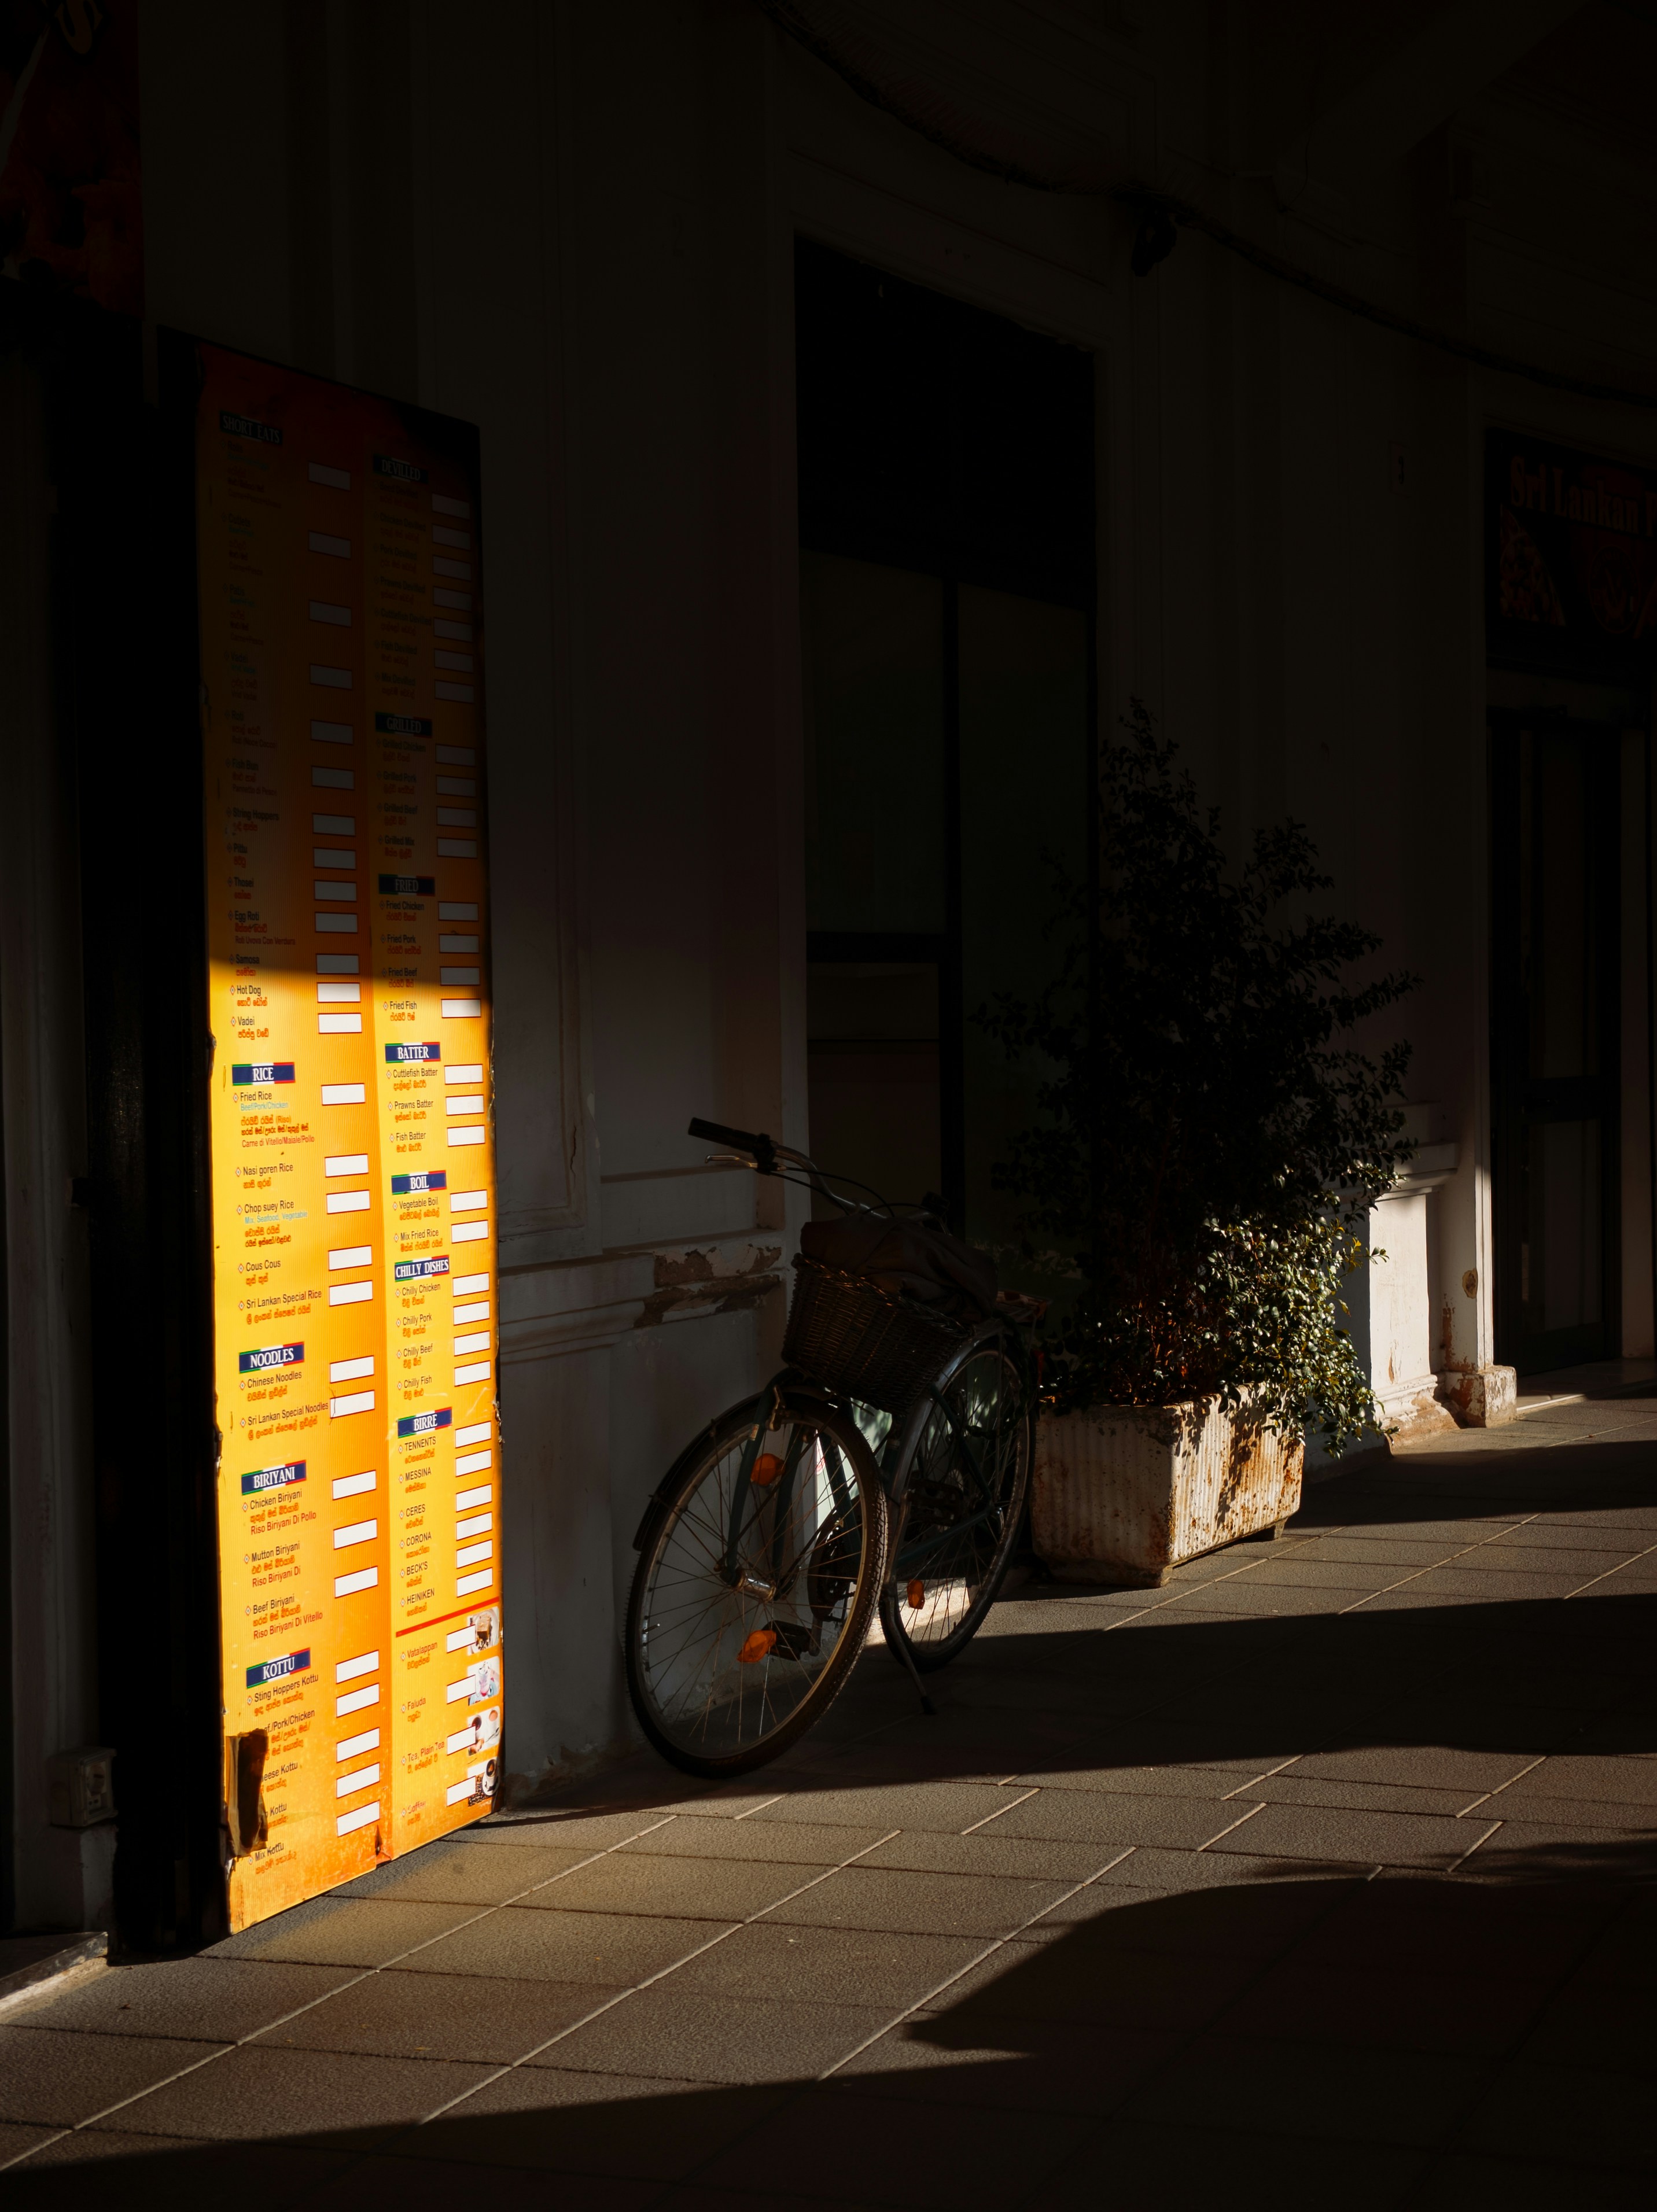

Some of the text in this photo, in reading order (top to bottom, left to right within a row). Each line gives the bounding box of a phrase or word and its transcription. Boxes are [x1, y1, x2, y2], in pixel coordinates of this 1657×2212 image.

[223, 415, 279, 444] SHORT EATS
[382, 459, 421, 481] DEVILLED
[1510, 455, 1546, 513] Sri
[1552, 466, 1639, 534] Lankan
[381, 640, 393, 650] Fish
[232, 711, 243, 721] Roti
[387, 717, 421, 733] GRILLED
[383, 739, 426, 752] Grilled Chicken
[233, 758, 258, 770] Fish Bun
[384, 770, 417, 783] Grilled Pork
[233, 808, 279, 820] String Hoppers
[384, 803, 417, 814] Grilled Beef
[385, 835, 415, 846] Grilled Mix
[234, 843, 247, 853] Pittu
[234, 877, 253, 887] Thosei
[395, 879, 418, 891] FRIED
[386, 901, 424, 911] Fried Chicken
[235, 912, 259, 922] Egg Roti
[388, 934, 416, 943] Fried Pork
[236, 954, 259, 964] Samosa
[389, 968, 417, 976] Fried Beef
[237, 985, 261, 997] Hot Dog
[390, 1001, 417, 1009] Fried Fish
[238, 1016, 255, 1026] Vadei
[397, 1046, 429, 1059] BATTER
[253, 1067, 274, 1081] RICE
[393, 1069, 419, 1078] Cuttlefish
[241, 1091, 271, 1101] Fried Rice
[395, 1100, 433, 1109] Prawns Batter
[276, 1116, 291, 1124] (Riso)
[242, 1136, 315, 1148] Carne di Vitello/Maiale/Pollo
[396, 1131, 426, 1141] Fish Batter
[244, 1163, 293, 1176] Nasi goren Rice
[410, 1176, 429, 1190] BOIL
[245, 1200, 294, 1214] Chop suey Rice
[399, 1197, 439, 1210] Vegetable Boil
[401, 1229, 439, 1241] Mix Fried Rice
[246, 1259, 281, 1271] Cous Cous
[396, 1259, 448, 1277] CHILLY DISHES
[403, 1283, 440, 1296] Chilly Chicken
[246, 1290, 322, 1308] Sri Lankan Special Rice
[403, 1314, 432, 1326] Chilly Pork
[404, 1343, 433, 1357] Chilly Beef
[251, 1348, 294, 1368] NOODLES
[248, 1371, 301, 1388] Chinese Noodles
[404, 1376, 432, 1388] Chilly Fish
[248, 1402, 328, 1425] Sri Lankan Special Noodles
[414, 1414, 437, 1431] BIRRE
[405, 1437, 436, 1451] TENNENTS
[253, 1466, 295, 1489] BIRIYANI
[406, 1467, 431, 1481] MESSINA
[250, 1489, 302, 1510] Chicken Biriyani
[406, 1504, 425, 1517] CERES
[251, 1511, 316, 1535] Riso Biriyani Di Pollo
[407, 1532, 432, 1546] CORONA
[252, 1541, 300, 1562] Mutton Biriyani
[407, 1561, 428, 1575] BECK'S
[252, 1566, 300, 1587] Riso Biriyani Di
[407, 1588, 434, 1604] HEINIKEN
[253, 1594, 294, 1614] Beef Biriyani
[254, 1611, 322, 1639] Riso Biriyani Di Vitello
[407, 1642, 437, 1658] Vatalappan
[263, 1657, 295, 1679] KOTTU
[255, 1673, 318, 1702] Sting Hoppers Kottu
[408, 1698, 426, 1710] Faluda
[408, 1741, 444, 1763] Tea, Plain Tea
[262, 1763, 297, 1782] eese Kottu
[270, 1802, 286, 1814] Kottu
[256, 1842, 283, 1861] Mix Kottu
